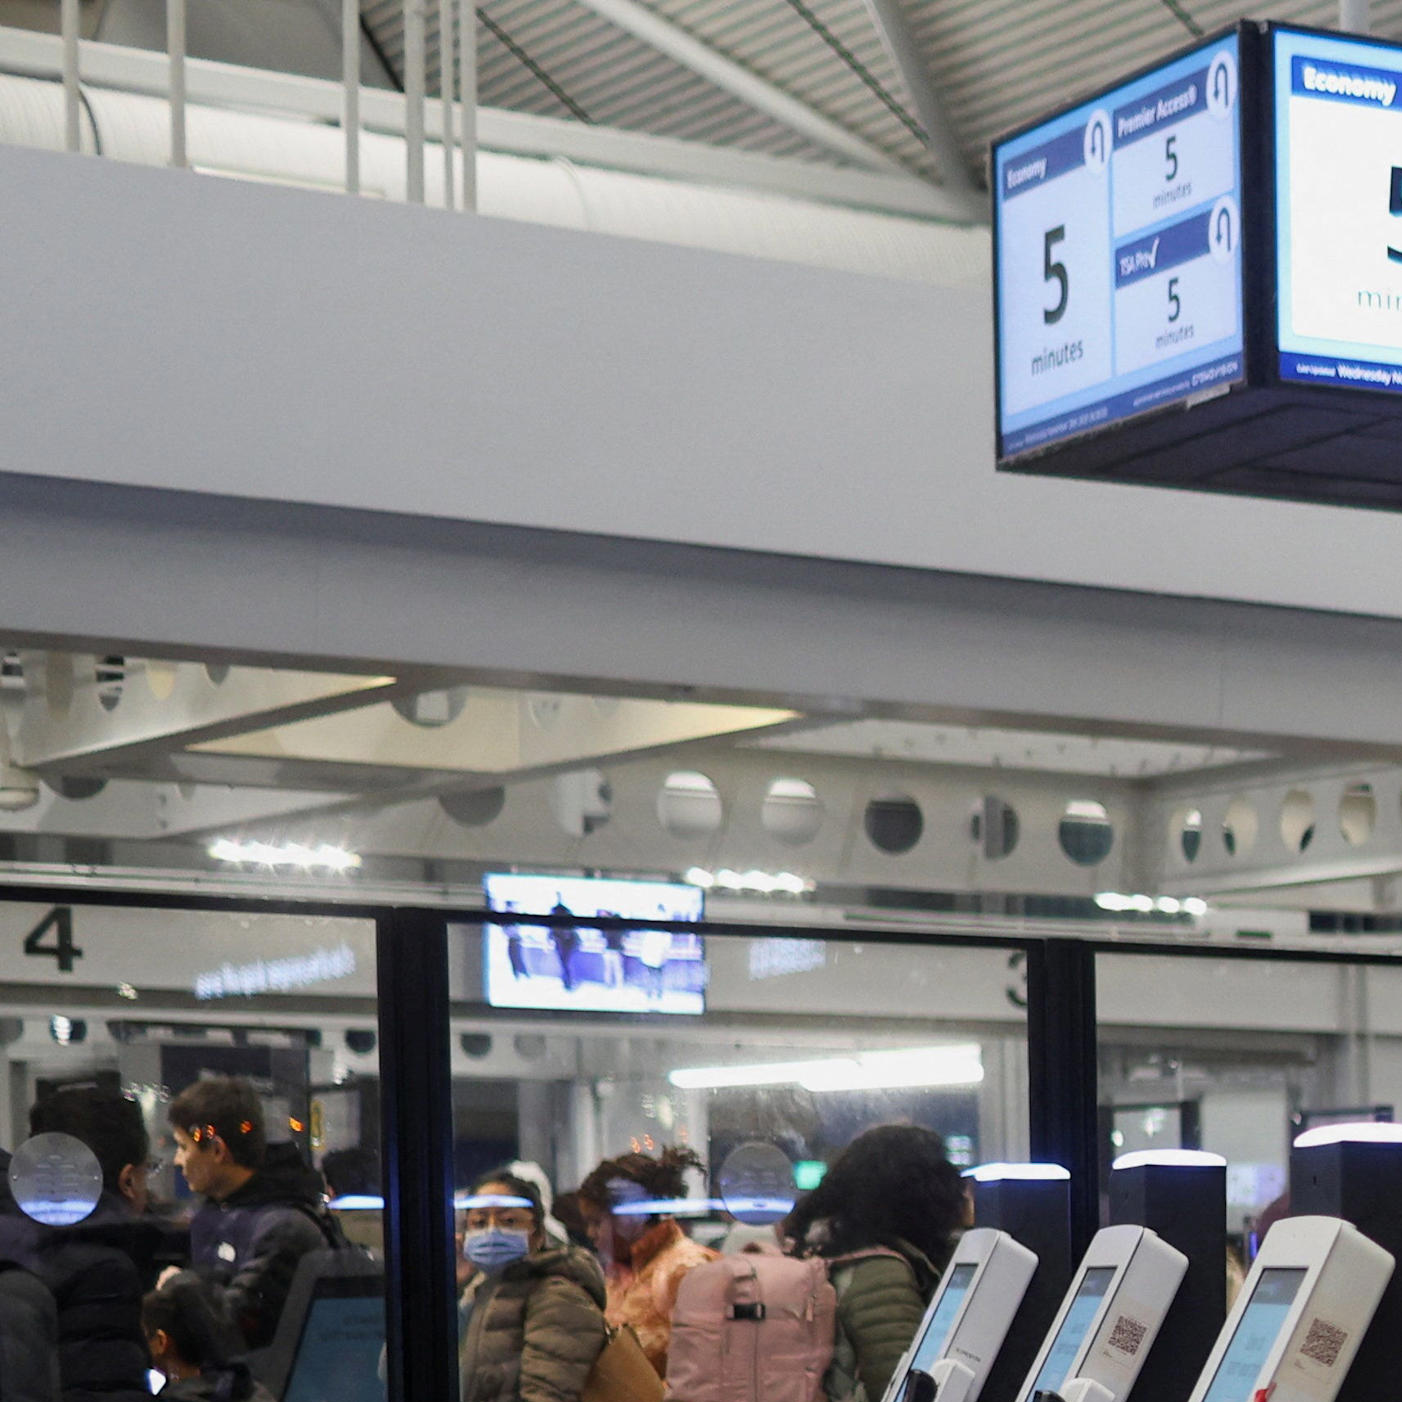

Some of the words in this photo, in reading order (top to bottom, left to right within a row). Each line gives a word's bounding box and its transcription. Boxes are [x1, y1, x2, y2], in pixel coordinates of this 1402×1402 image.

[1303, 65, 1397, 107] Economy
[1117, 106, 1156, 138] Premier
[1007, 157, 1047, 189] Economy
[1165, 136, 1178, 181] 5
[1153, 182, 1193, 209] minutes
[1043, 224, 1069, 325] 5
[1168, 277, 1180, 322] 5
[1156, 325, 1194, 348] minutes
[1031, 341, 1083, 376] minutes
[24, 904, 82, 972] 4
